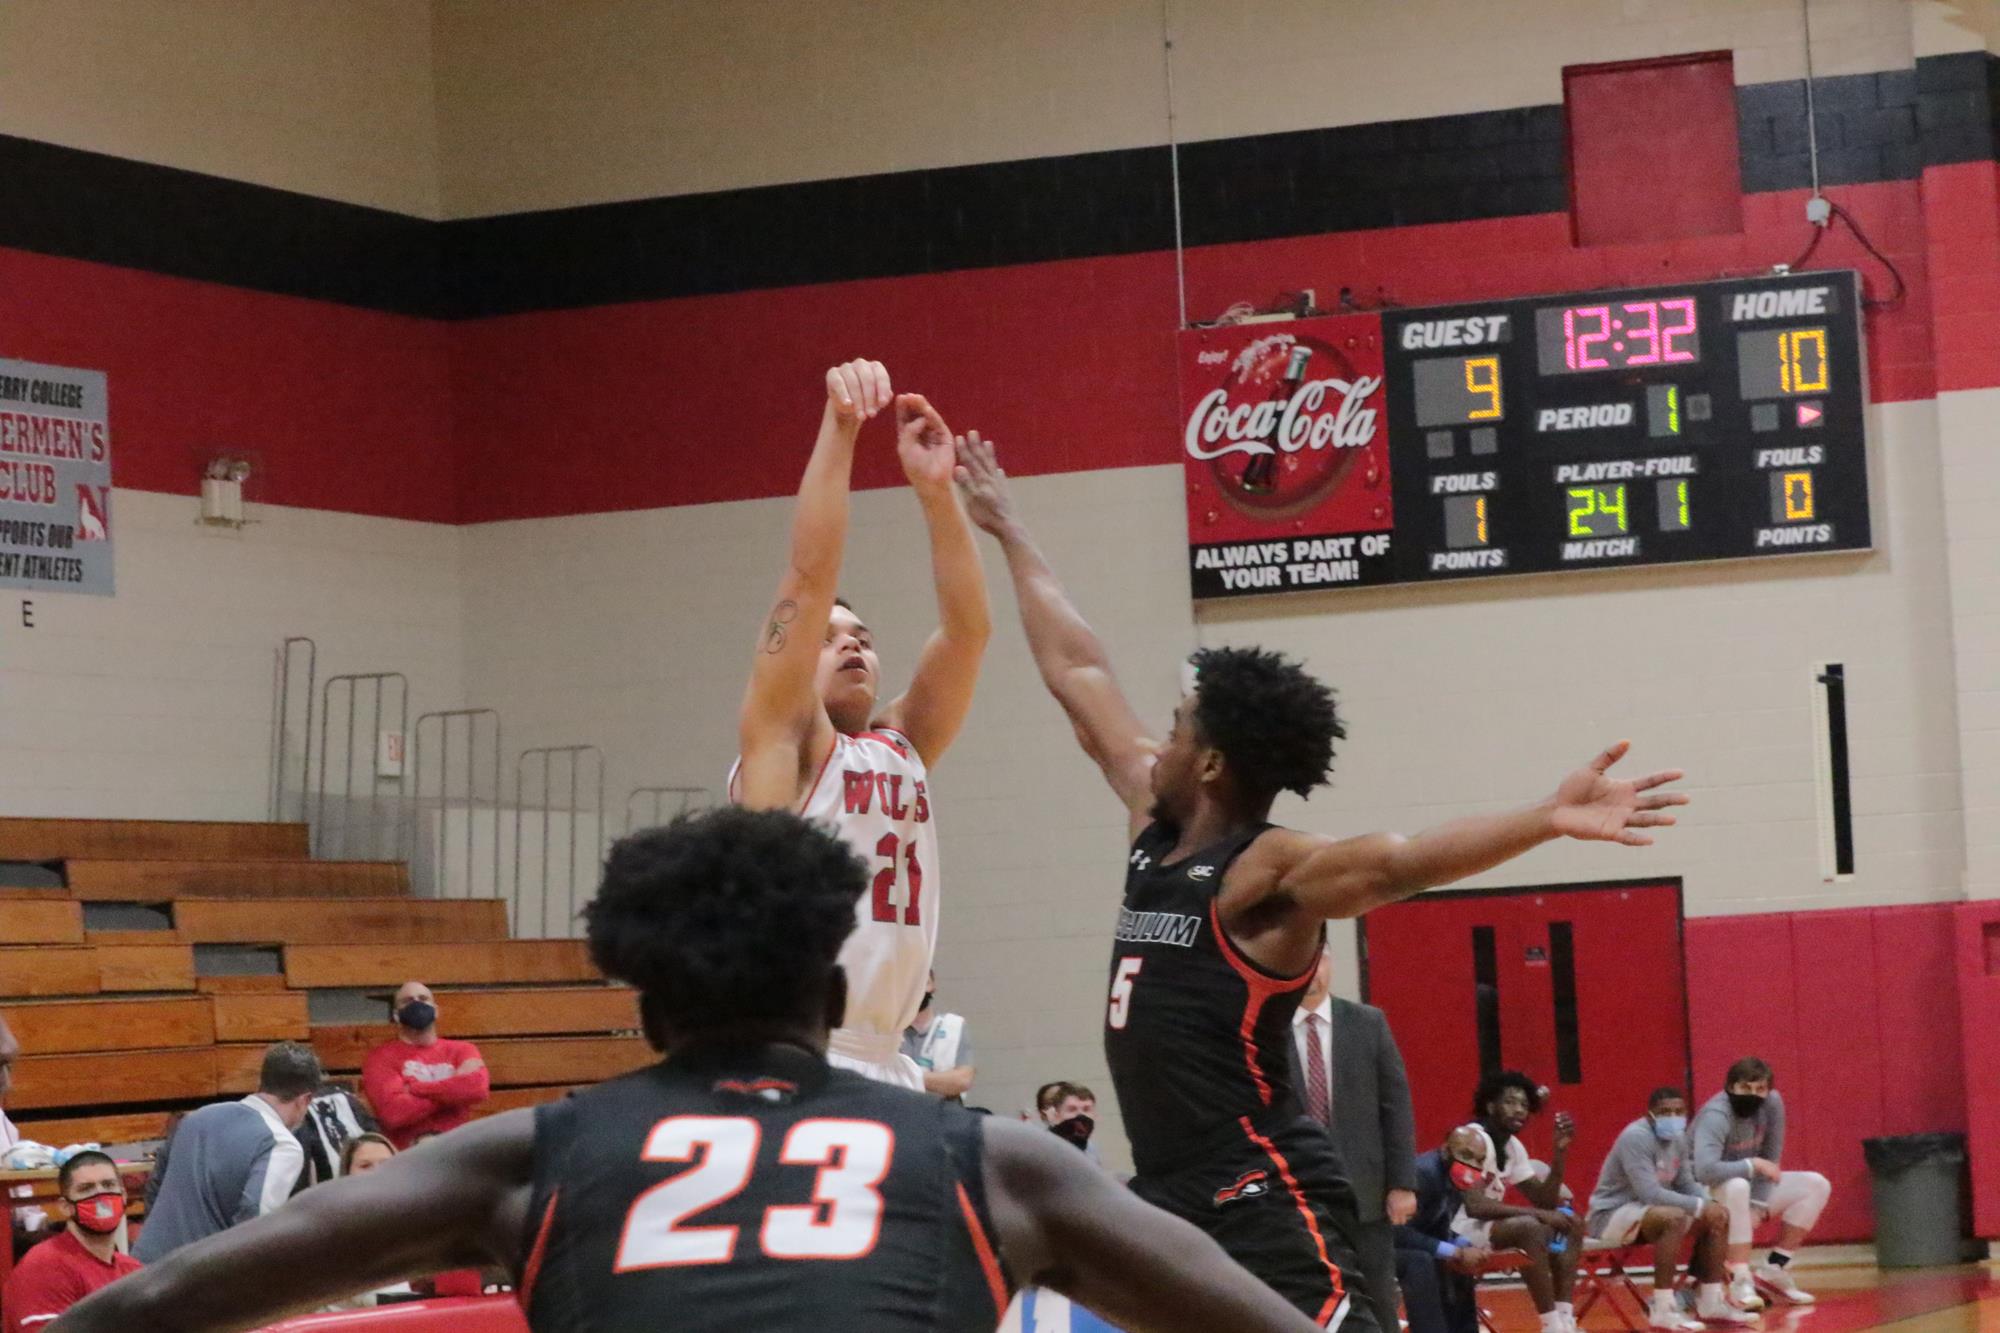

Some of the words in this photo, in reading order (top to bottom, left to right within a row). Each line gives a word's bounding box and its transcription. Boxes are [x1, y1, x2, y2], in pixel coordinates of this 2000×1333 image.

[1733, 287, 1828, 321] HOME
[1402, 315, 1507, 349] GUEST
[1563, 298, 1696, 369] 12:32
[1778, 329, 1828, 393] 10
[31, 379, 83, 409] COLLEGE
[1465, 357, 1501, 419] 9
[1186, 375, 1381, 459] Coca-Cola
[1538, 403, 1632, 432] PERIOD
[1667, 386, 1679, 433] 1
[1557, 456, 1695, 483] PLAYER-FOUL
[1758, 446, 1822, 468] FOULS
[0, 461, 56, 504] CLUB
[1432, 472, 1496, 493] FOULS
[1784, 472, 1814, 520] 0
[1475, 497, 1488, 543] 1
[1568, 485, 1628, 535] 24
[1677, 481, 1689, 527] 1
[1195, 543, 1288, 569] ALWAYS
[1293, 537, 1356, 560] PART
[1360, 534, 1391, 556] OF
[1563, 539, 1635, 560] MATCH
[1757, 525, 1830, 546] POINTS
[22, 554, 82, 582] ATHLETES
[1220, 565, 1281, 589] YOUR
[1286, 560, 1359, 584] TEAM!
[1431, 549, 1504, 570] POINTS
[23, 600, 34, 628] E
[873, 832, 922, 926] 21
[1108, 957, 1143, 1030] 5
[612, 1115, 895, 1274] 23
